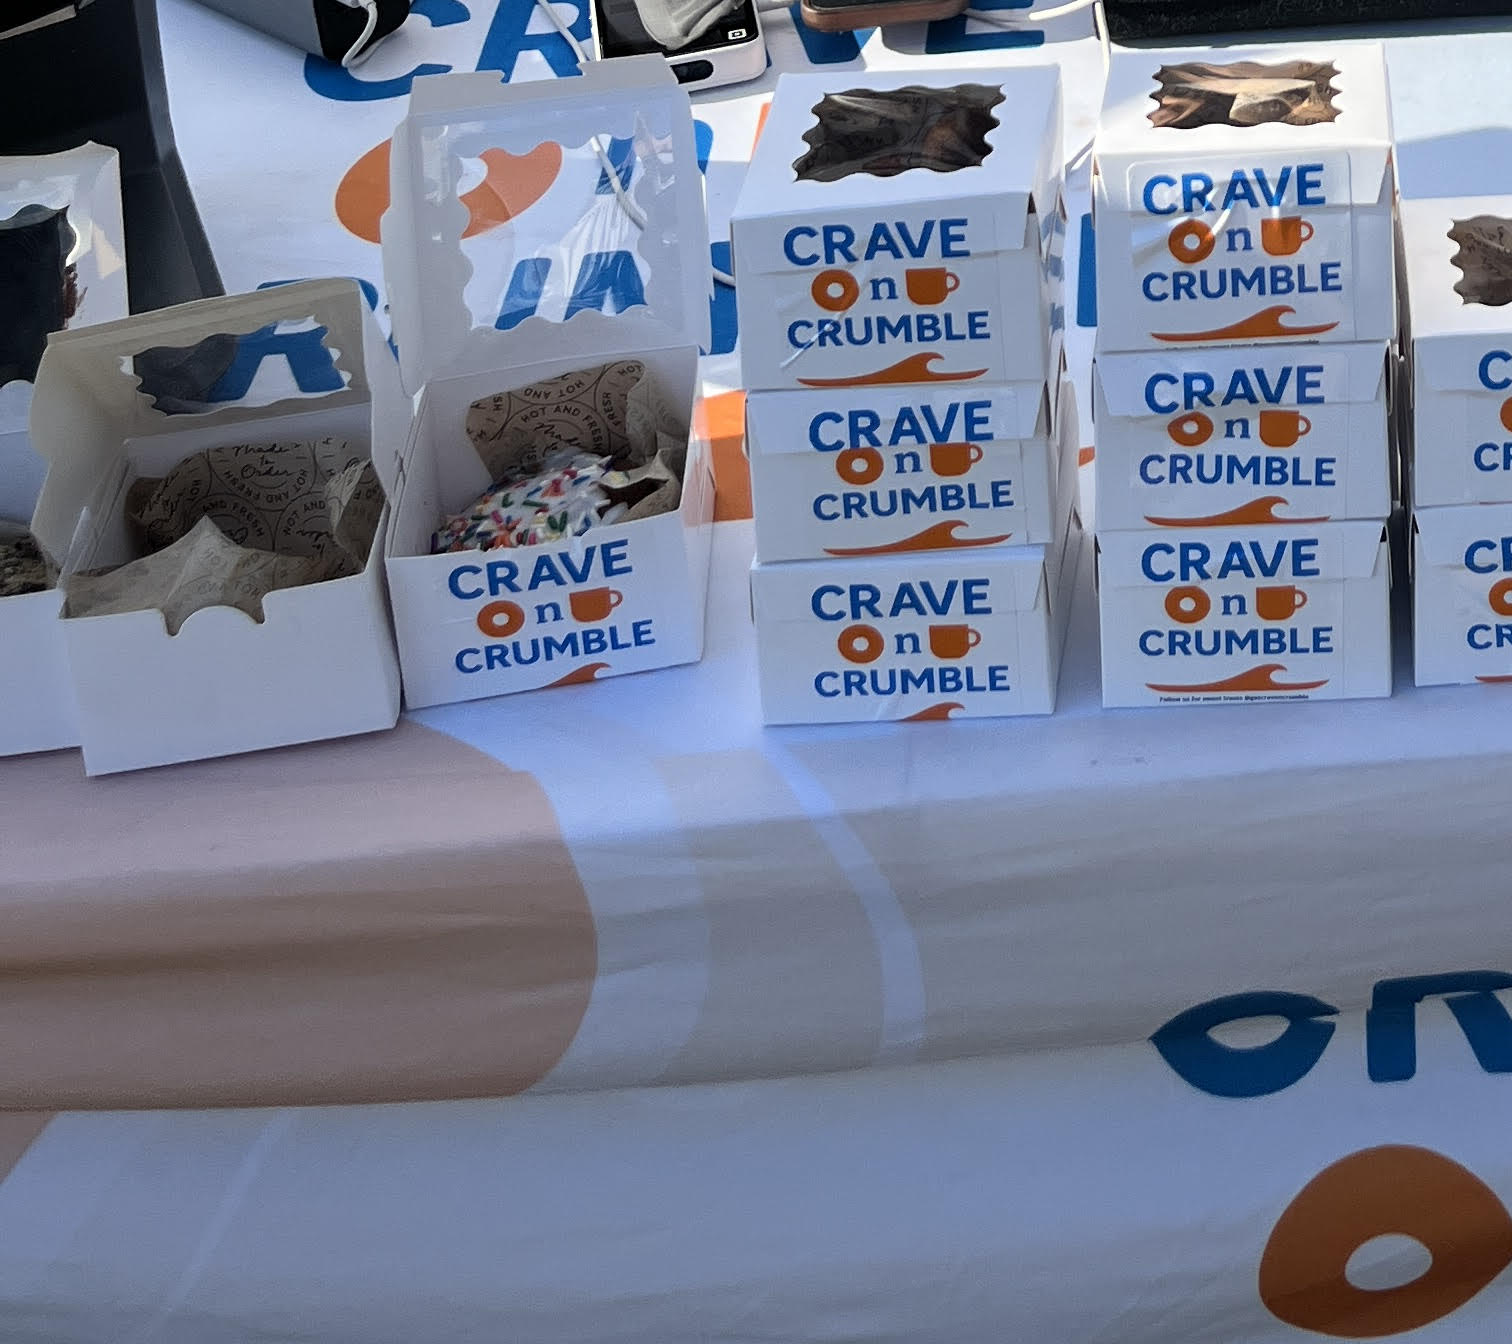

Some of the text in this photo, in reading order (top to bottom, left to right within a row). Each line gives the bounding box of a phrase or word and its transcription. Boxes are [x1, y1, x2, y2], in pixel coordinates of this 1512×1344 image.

[1142, 164, 1326, 216] CRAVE
[783, 218, 969, 267] CRAVE
[1141, 262, 1343, 302] CRUMBLE
[787, 311, 991, 351] CRUMBLE
[1144, 365, 1325, 415] CRAVE
[520, 406, 548, 424] HOT
[552, 405, 581, 418] AND
[808, 399, 994, 453] CRAVE
[1139, 453, 1336, 487] CRUMBLE
[812, 479, 1014, 521] CRUMBLE
[447, 539, 633, 601] CRAVE
[1141, 538, 1320, 583] CRAVE
[811, 578, 993, 622] CRAVE
[455, 619, 657, 675] CRUMBLE
[1138, 626, 1334, 657] CRUMBLE
[814, 665, 1011, 698] CRUMBLE
